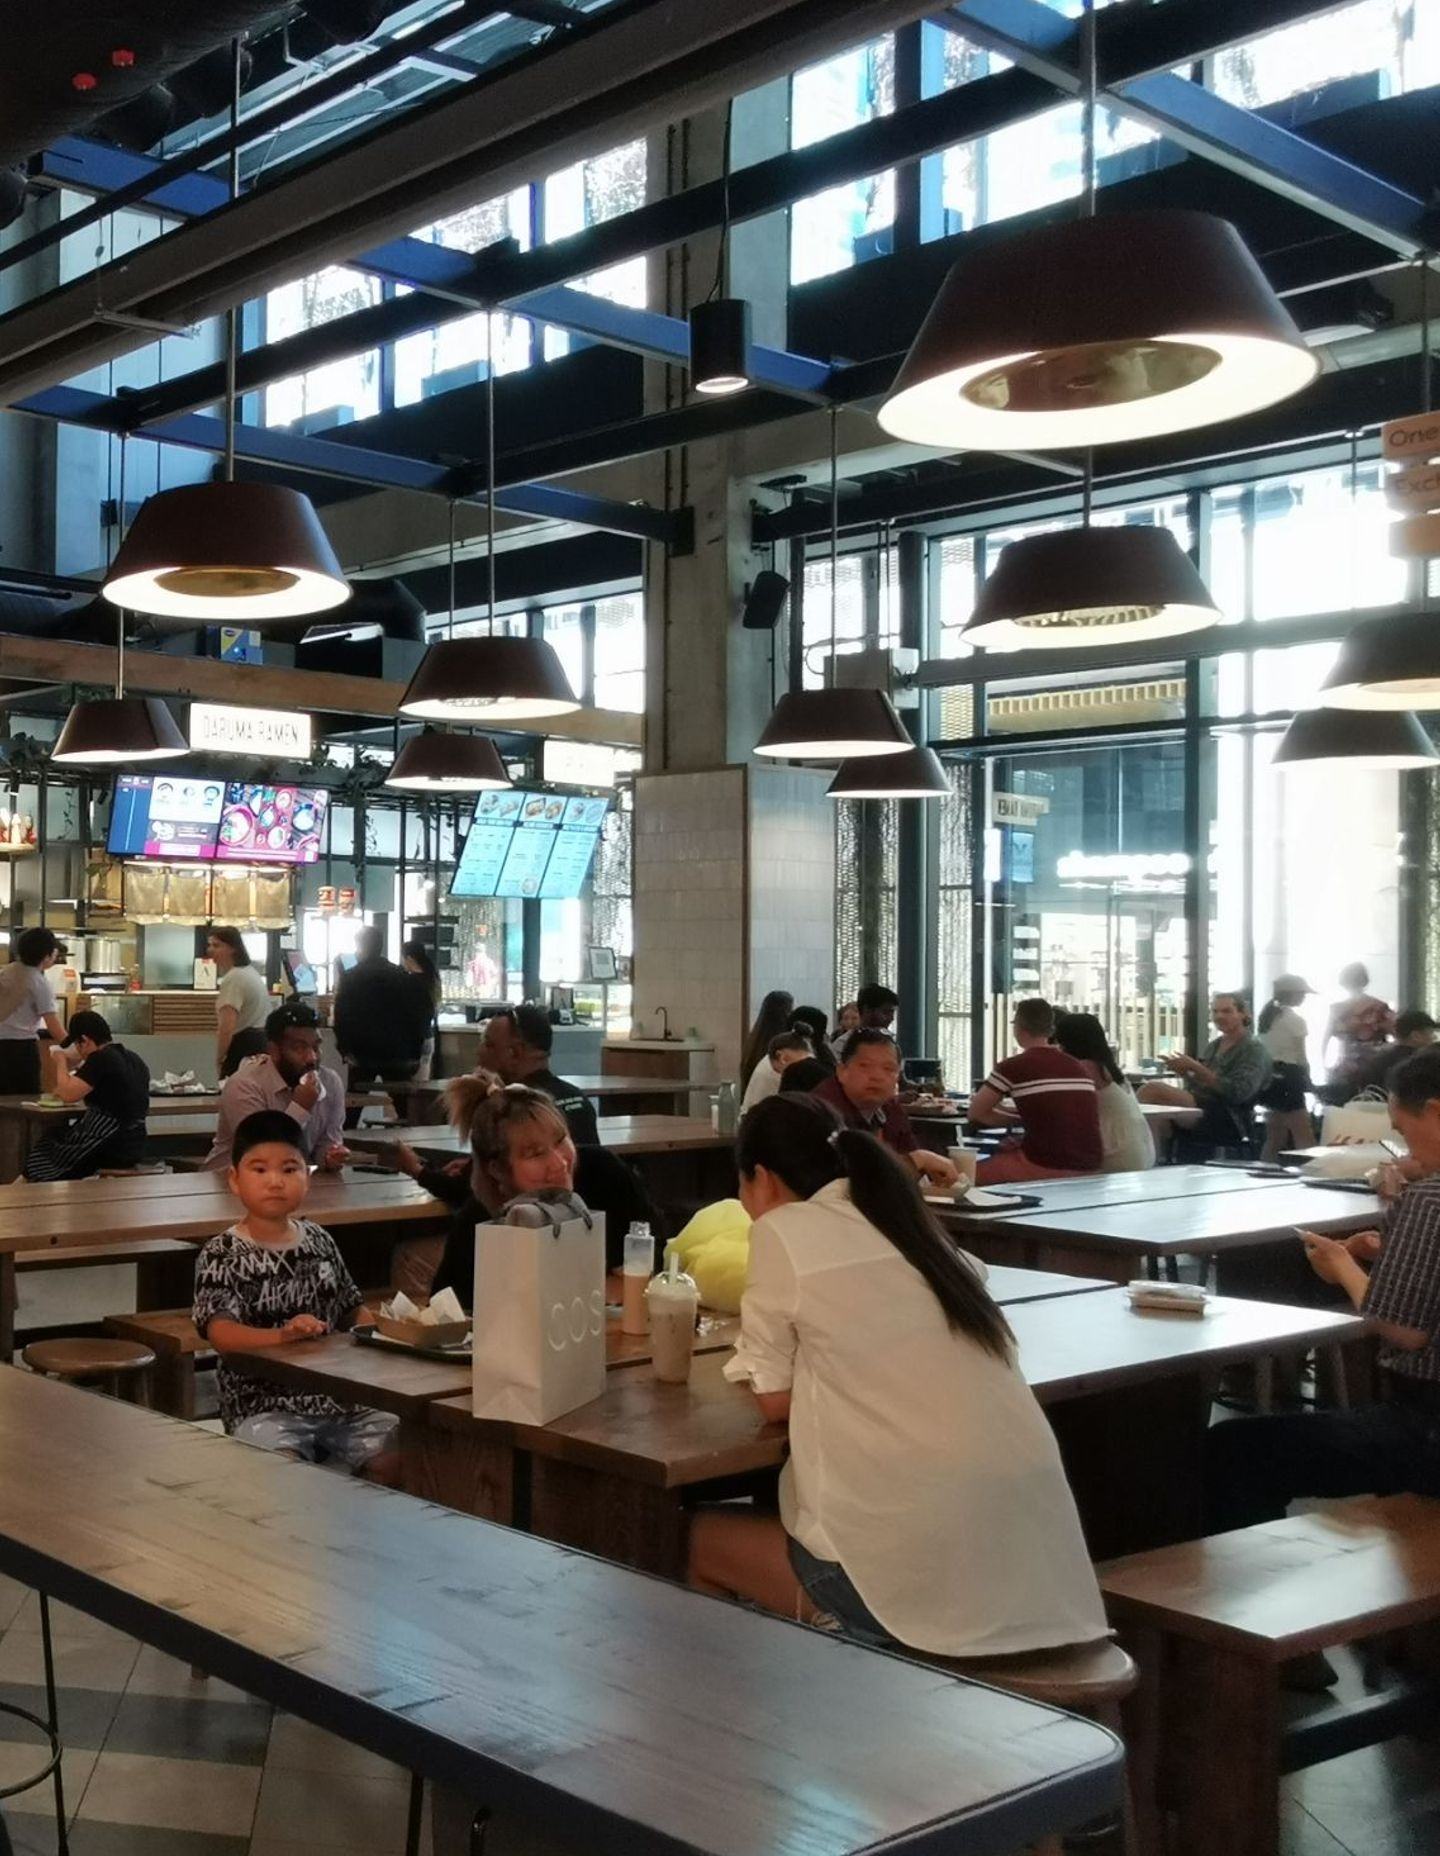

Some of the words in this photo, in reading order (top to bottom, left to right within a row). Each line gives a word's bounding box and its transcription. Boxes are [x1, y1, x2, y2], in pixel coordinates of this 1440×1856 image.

[203, 715, 252, 741] DARUMA
[257, 720, 299, 746] RAMEN
[548, 1290, 602, 1351] COS
